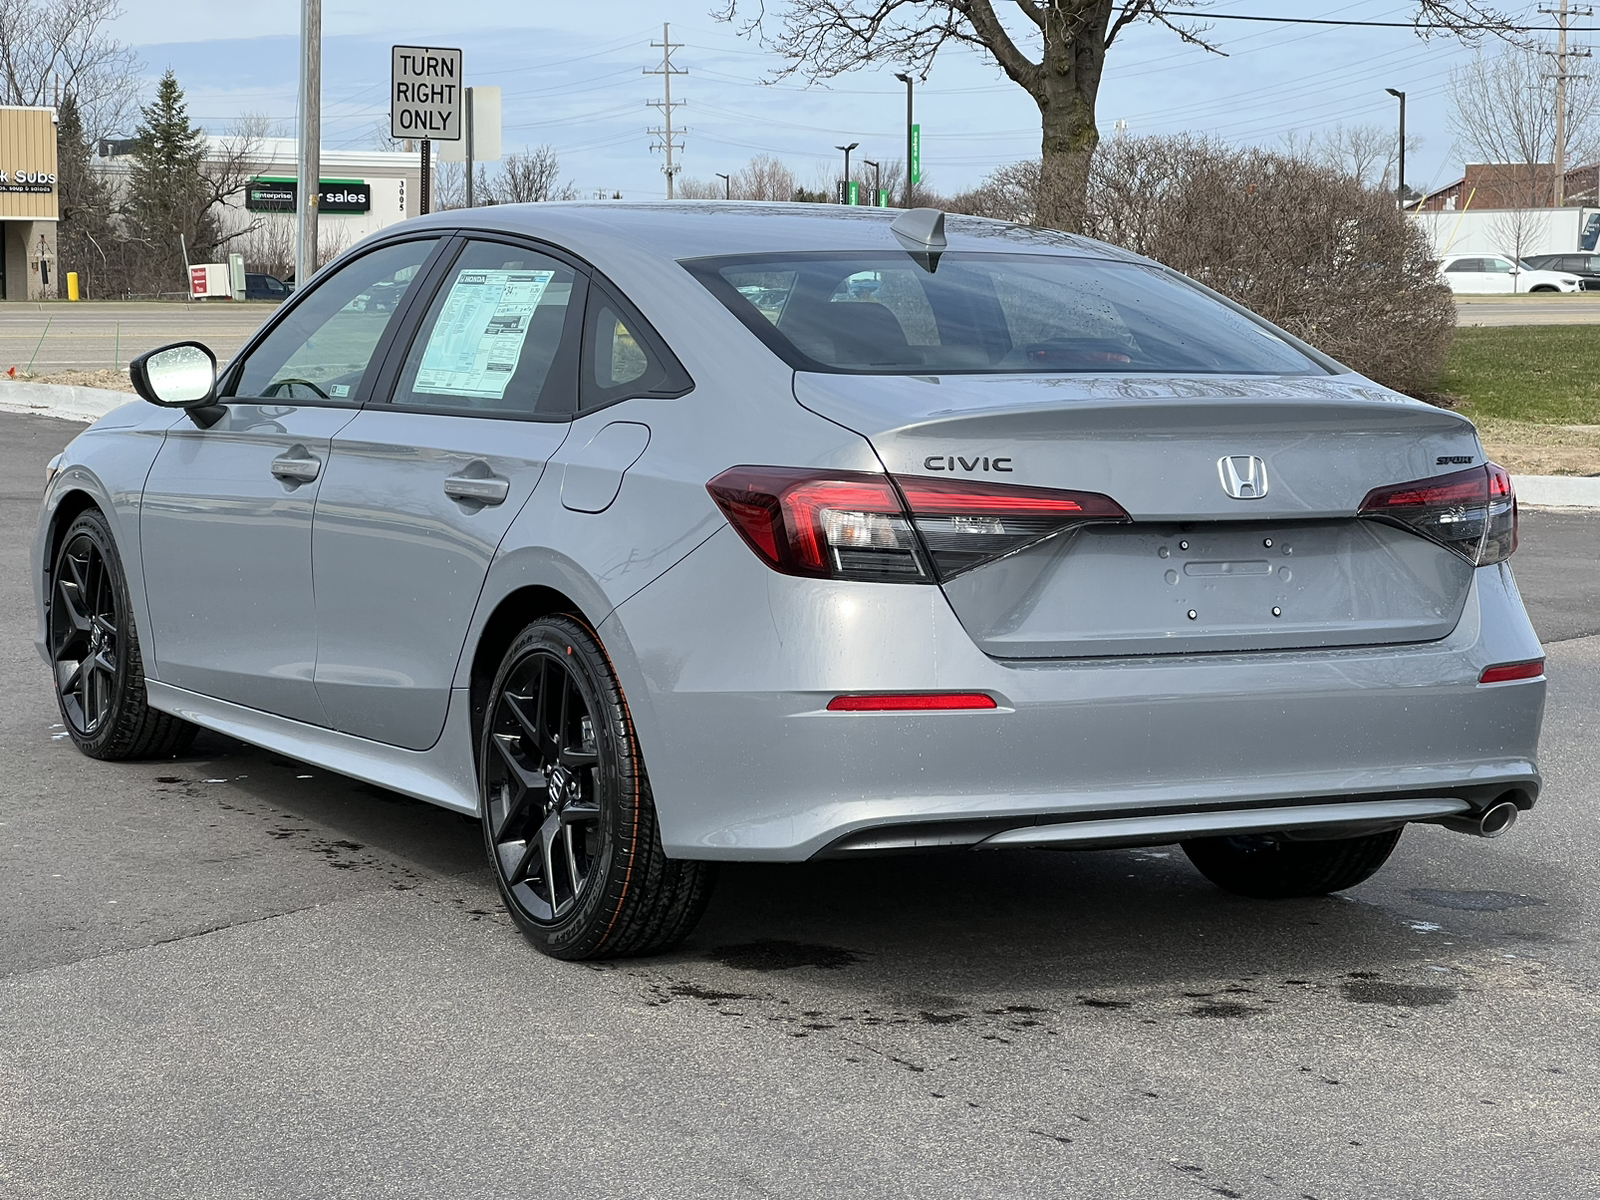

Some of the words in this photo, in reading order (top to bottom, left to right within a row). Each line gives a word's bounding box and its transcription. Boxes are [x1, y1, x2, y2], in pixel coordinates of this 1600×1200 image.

[400, 55, 454, 78] TURN
[397, 82, 456, 104] RIGHT
[400, 109, 452, 131] ONLY
[0, 170, 9, 182] k
[15, 169, 56, 184] Subs
[252, 191, 292, 200] enterprise
[326, 190, 366, 203] sales
[923, 456, 1013, 472] CIVIC
[1436, 456, 1475, 465] SPORT
